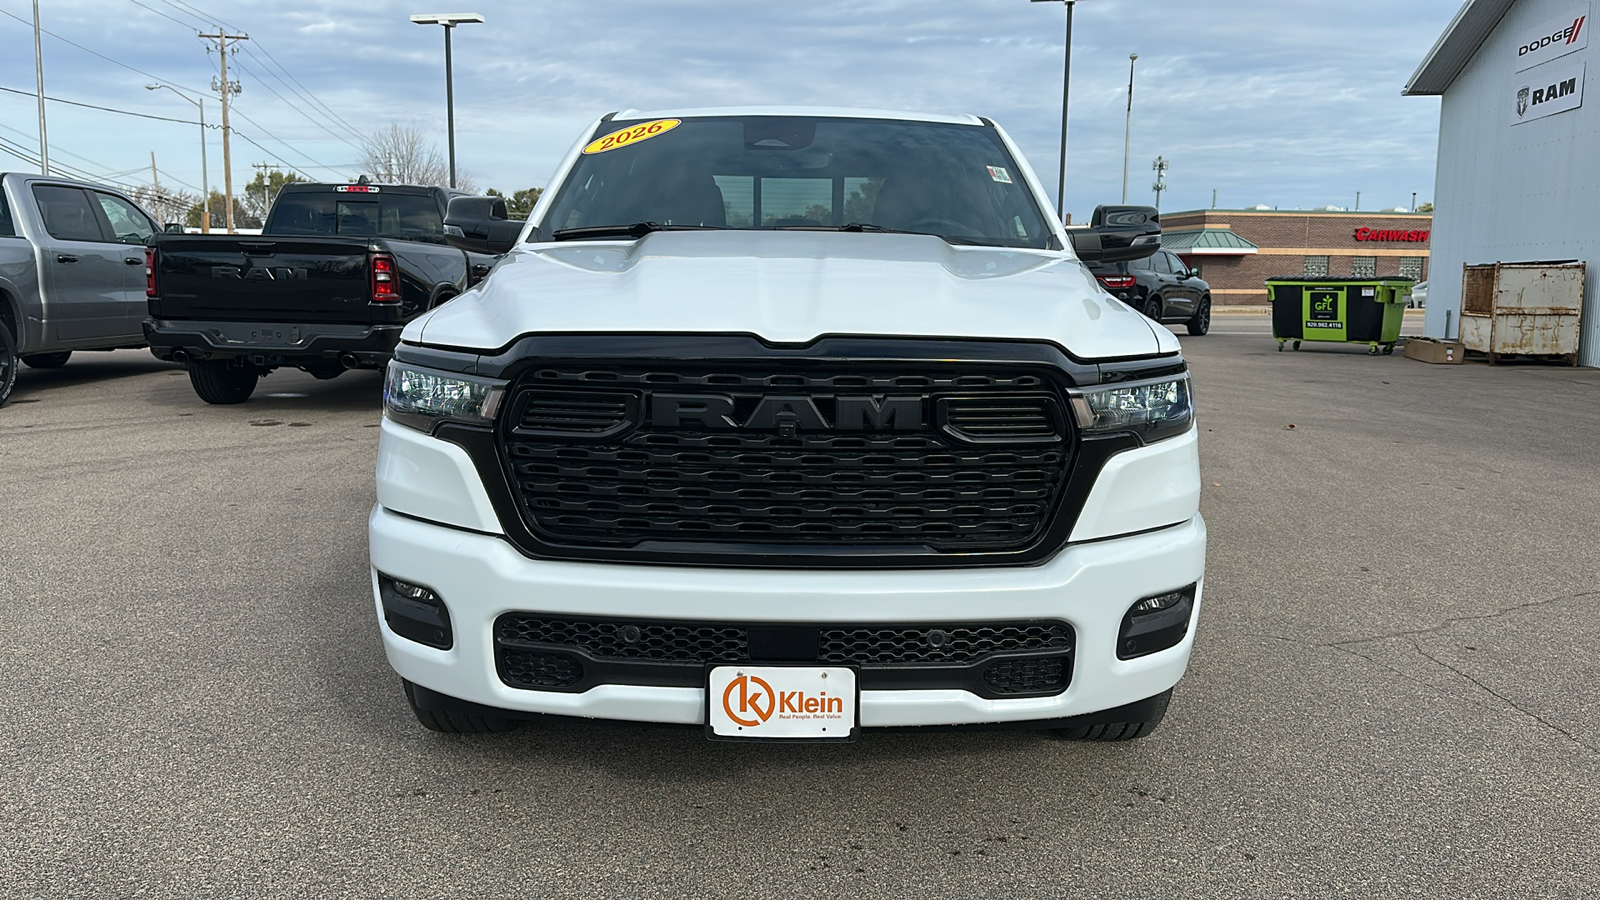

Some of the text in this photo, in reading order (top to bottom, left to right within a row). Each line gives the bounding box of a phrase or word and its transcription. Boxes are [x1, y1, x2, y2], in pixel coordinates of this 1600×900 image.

[1518, 26, 1574, 56] DODGE
[1532, 77, 1576, 105] RAM
[600, 121, 664, 151] 2026
[211, 266, 308, 280] RAM
[1314, 299, 1333, 310] GFL
[652, 393, 922, 430] RAM
[779, 691, 843, 713] Klein
